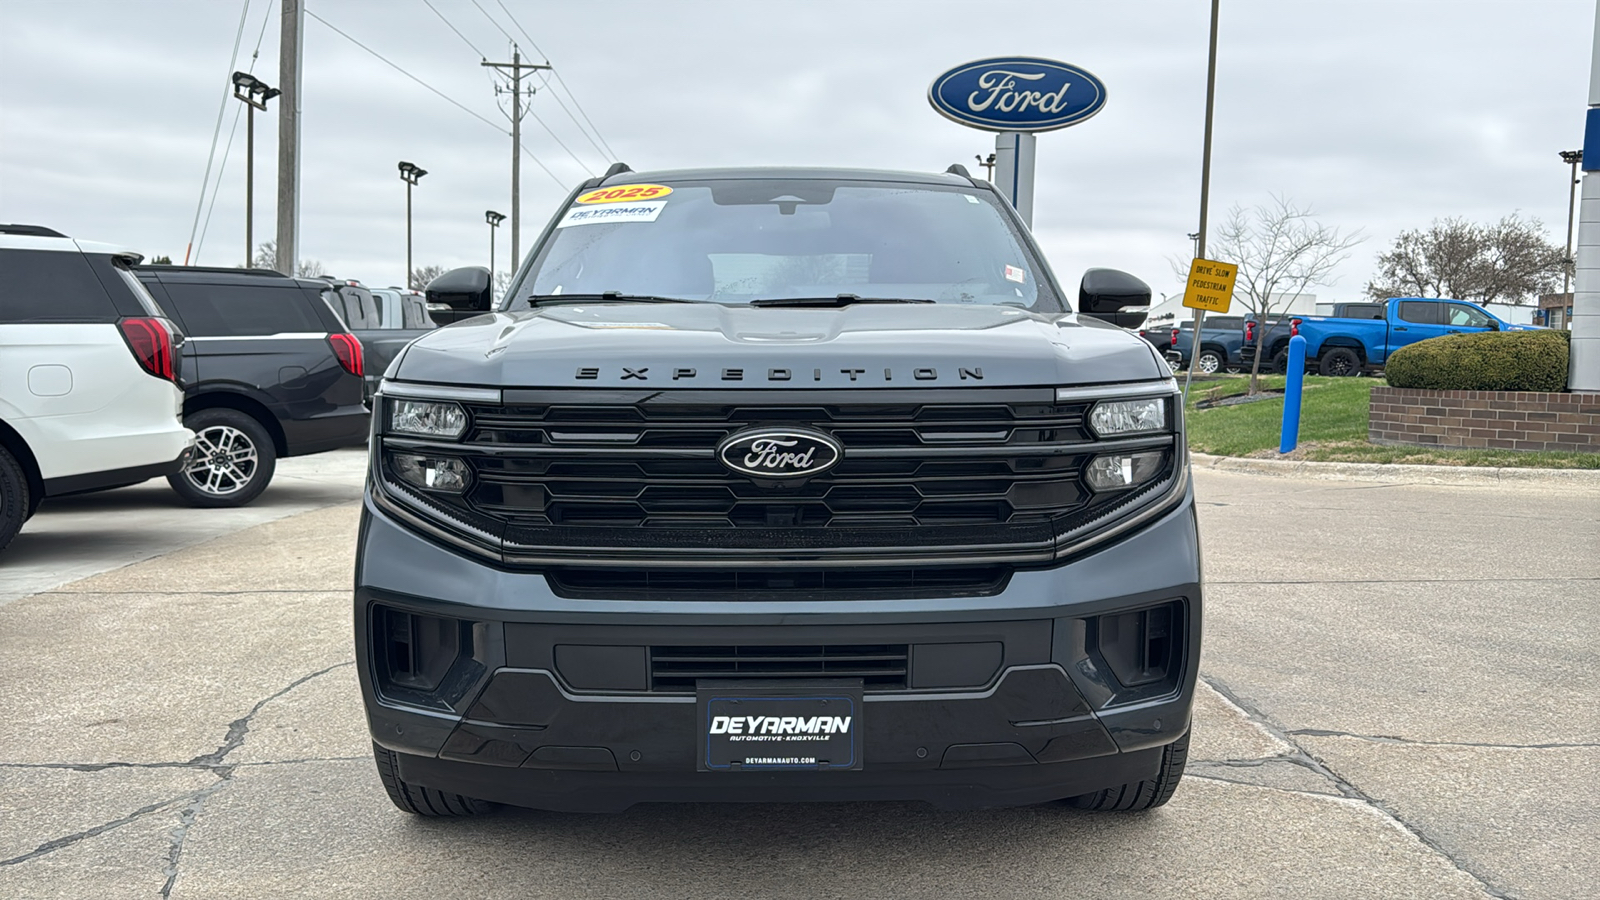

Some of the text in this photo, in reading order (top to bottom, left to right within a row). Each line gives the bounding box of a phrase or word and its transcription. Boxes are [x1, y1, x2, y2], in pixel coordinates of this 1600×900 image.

[967, 70, 1071, 113] Ford
[583, 187, 664, 202] 2025
[570, 206, 658, 219] DEYARMAN
[1195, 265, 1230, 278] DRIVE SLOW
[1192, 279, 1227, 292] PEDESTRIAN
[1196, 294, 1219, 306] TRAFFIC
[575, 366, 984, 382] EXPEDITION
[743, 438, 815, 469] Ford
[709, 716, 851, 735] DEYARMAN
